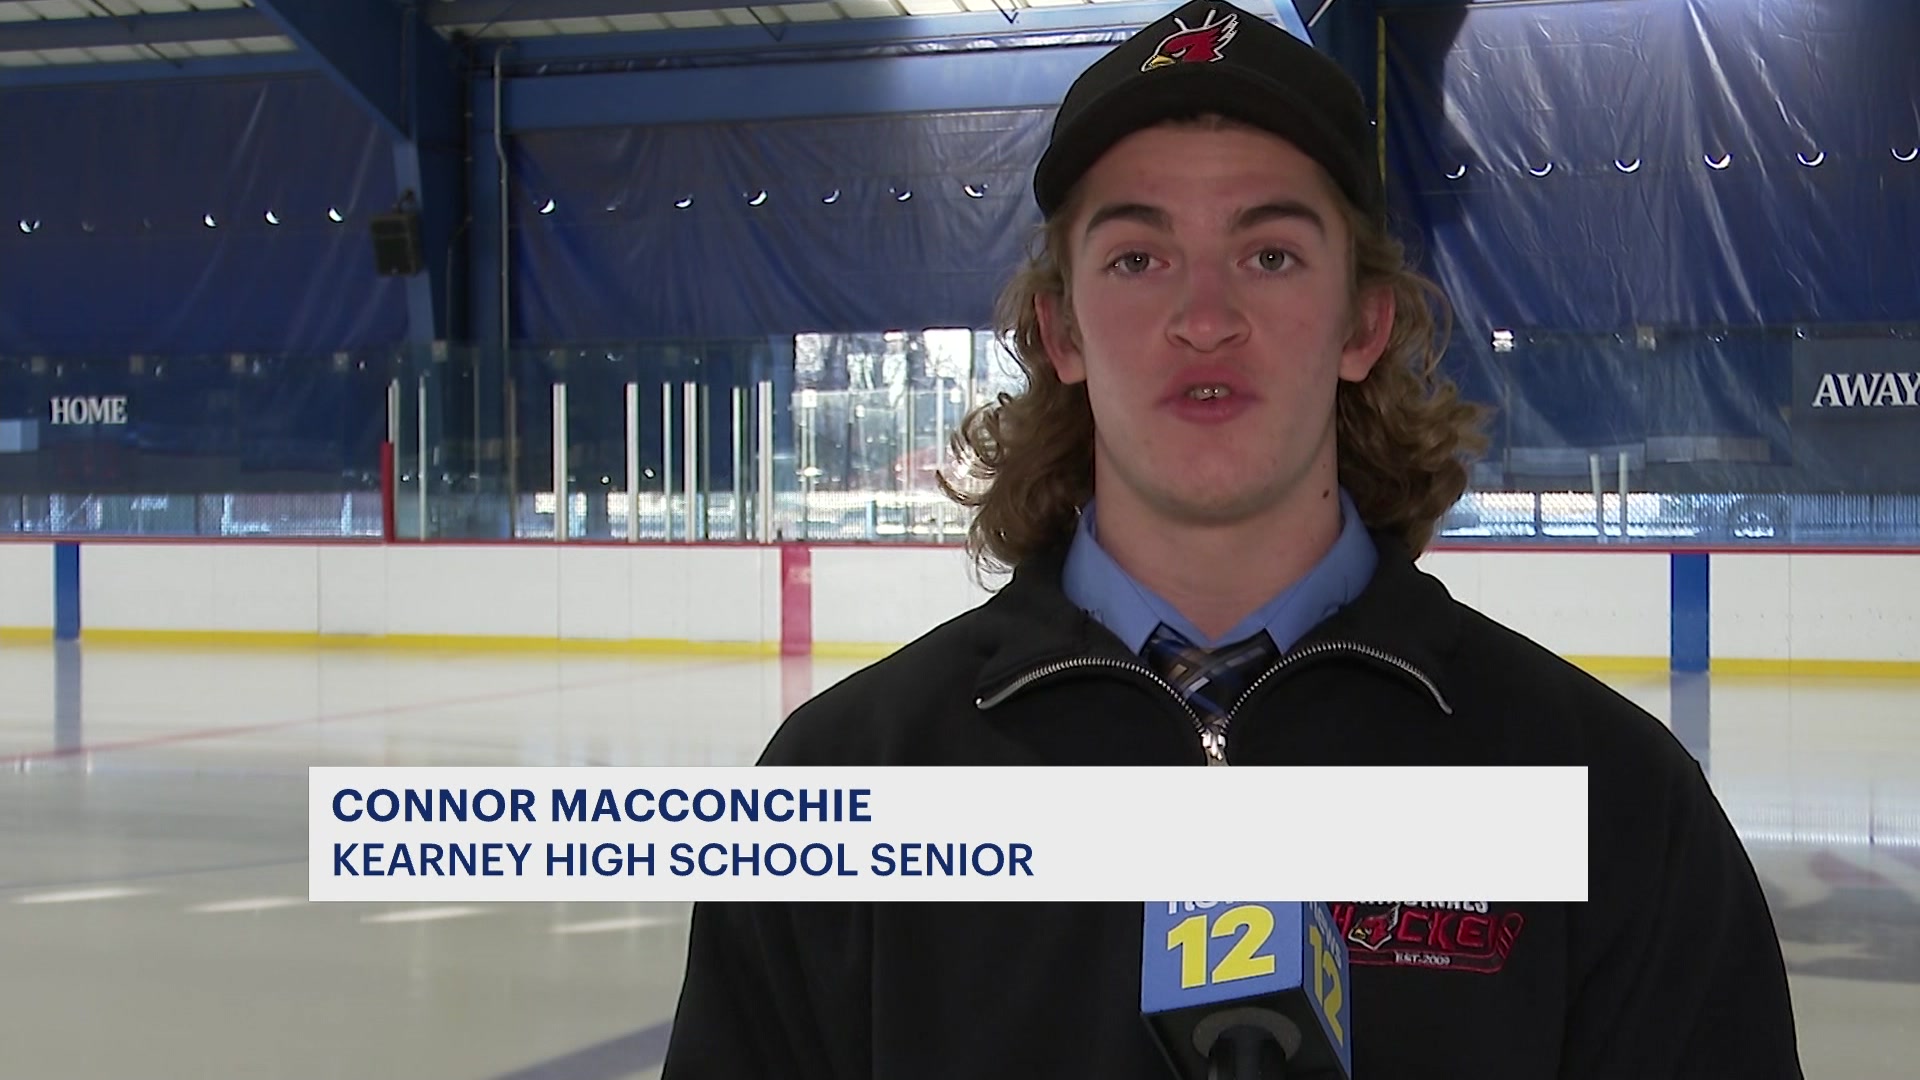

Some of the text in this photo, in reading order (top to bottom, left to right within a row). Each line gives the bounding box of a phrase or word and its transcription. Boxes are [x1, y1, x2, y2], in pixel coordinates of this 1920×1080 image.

[51, 397, 127, 424] HOME
[1812, 372, 1920, 407] AWAY
[1166, 904, 1275, 989] 12
[1308, 923, 1343, 1047] 12
